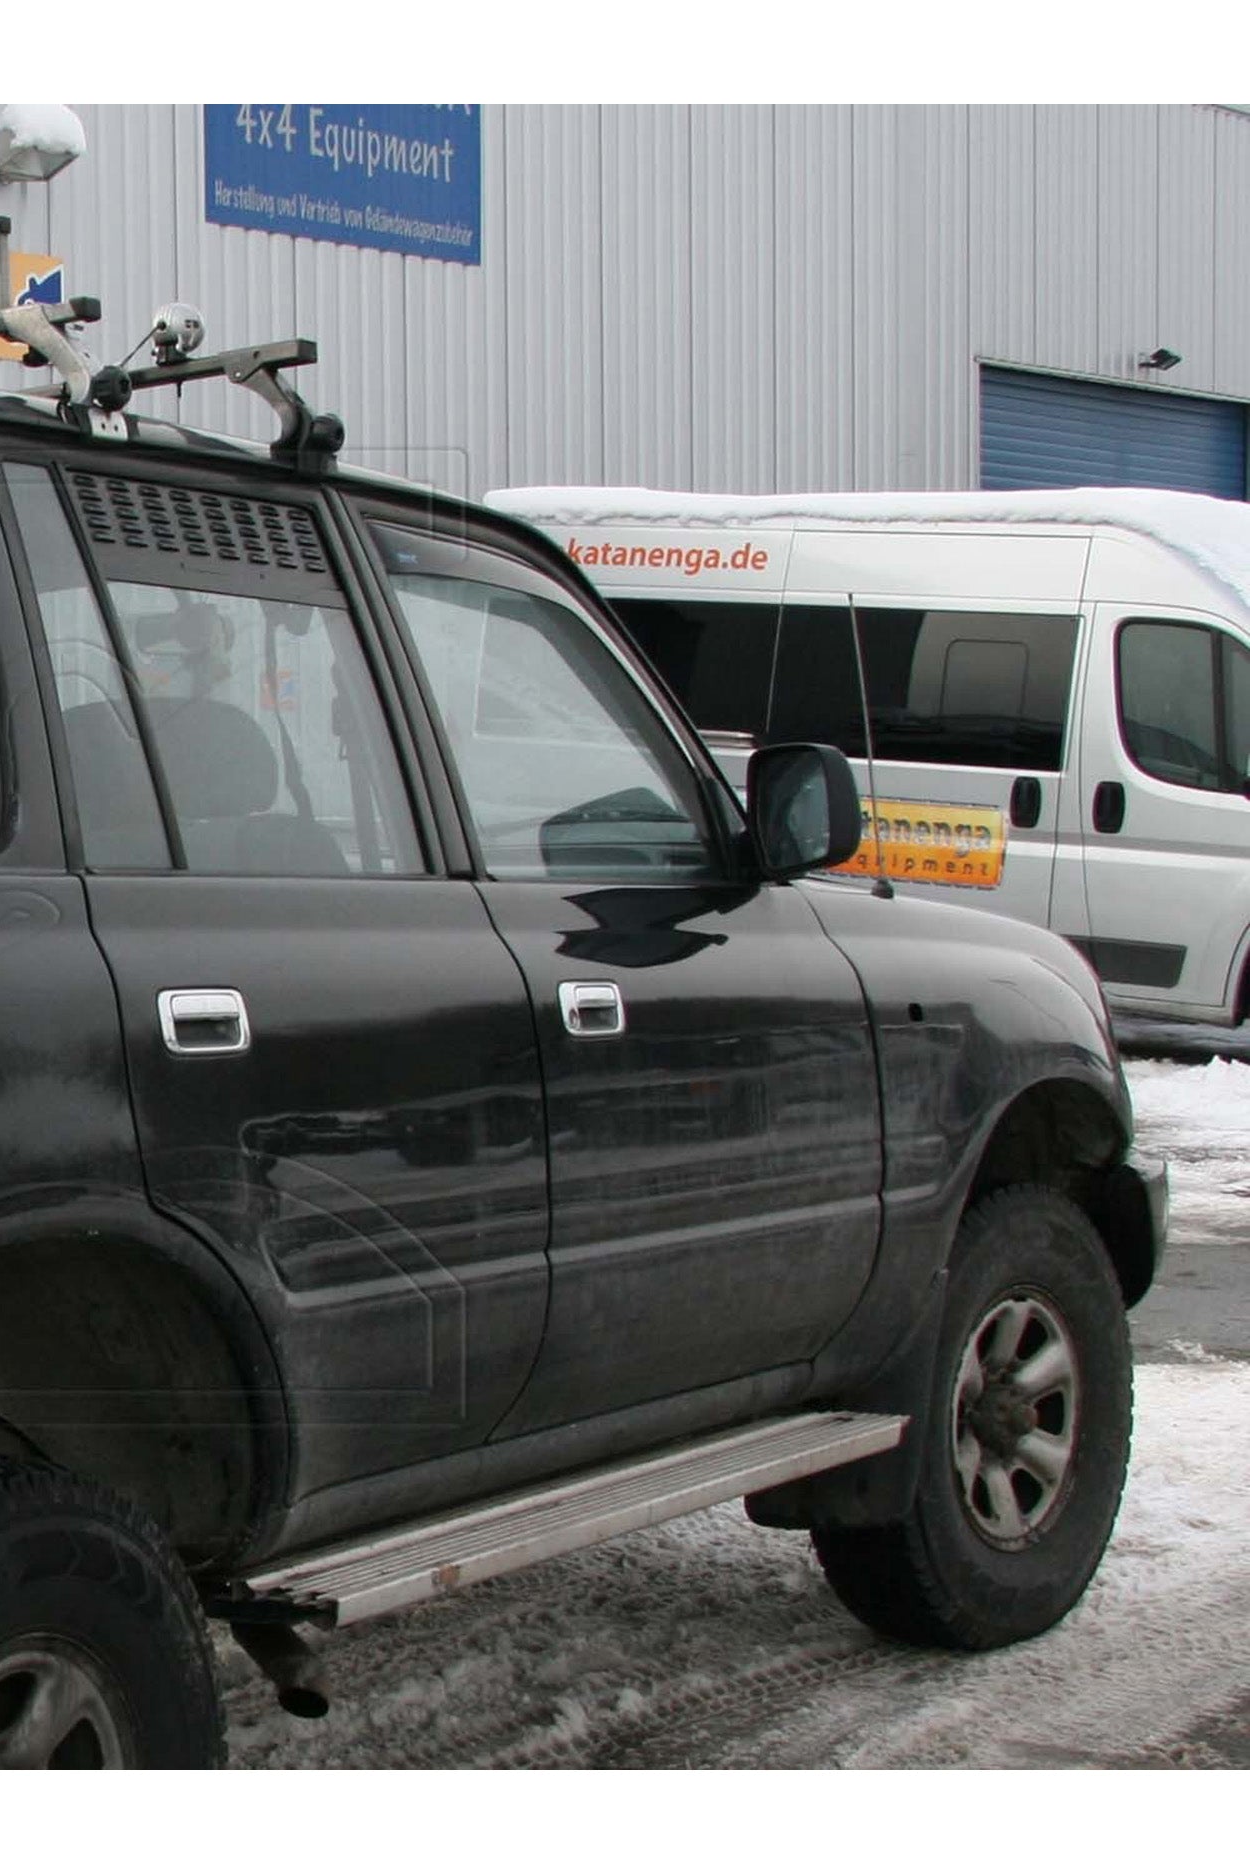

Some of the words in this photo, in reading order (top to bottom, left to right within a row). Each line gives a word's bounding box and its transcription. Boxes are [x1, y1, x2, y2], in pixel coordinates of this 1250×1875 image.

[236, 104, 297, 151] 4x4
[309, 108, 454, 182] Equipment
[277, 194, 297, 217] und
[344, 209, 363, 229] von
[568, 538, 768, 575] katanenga.de
